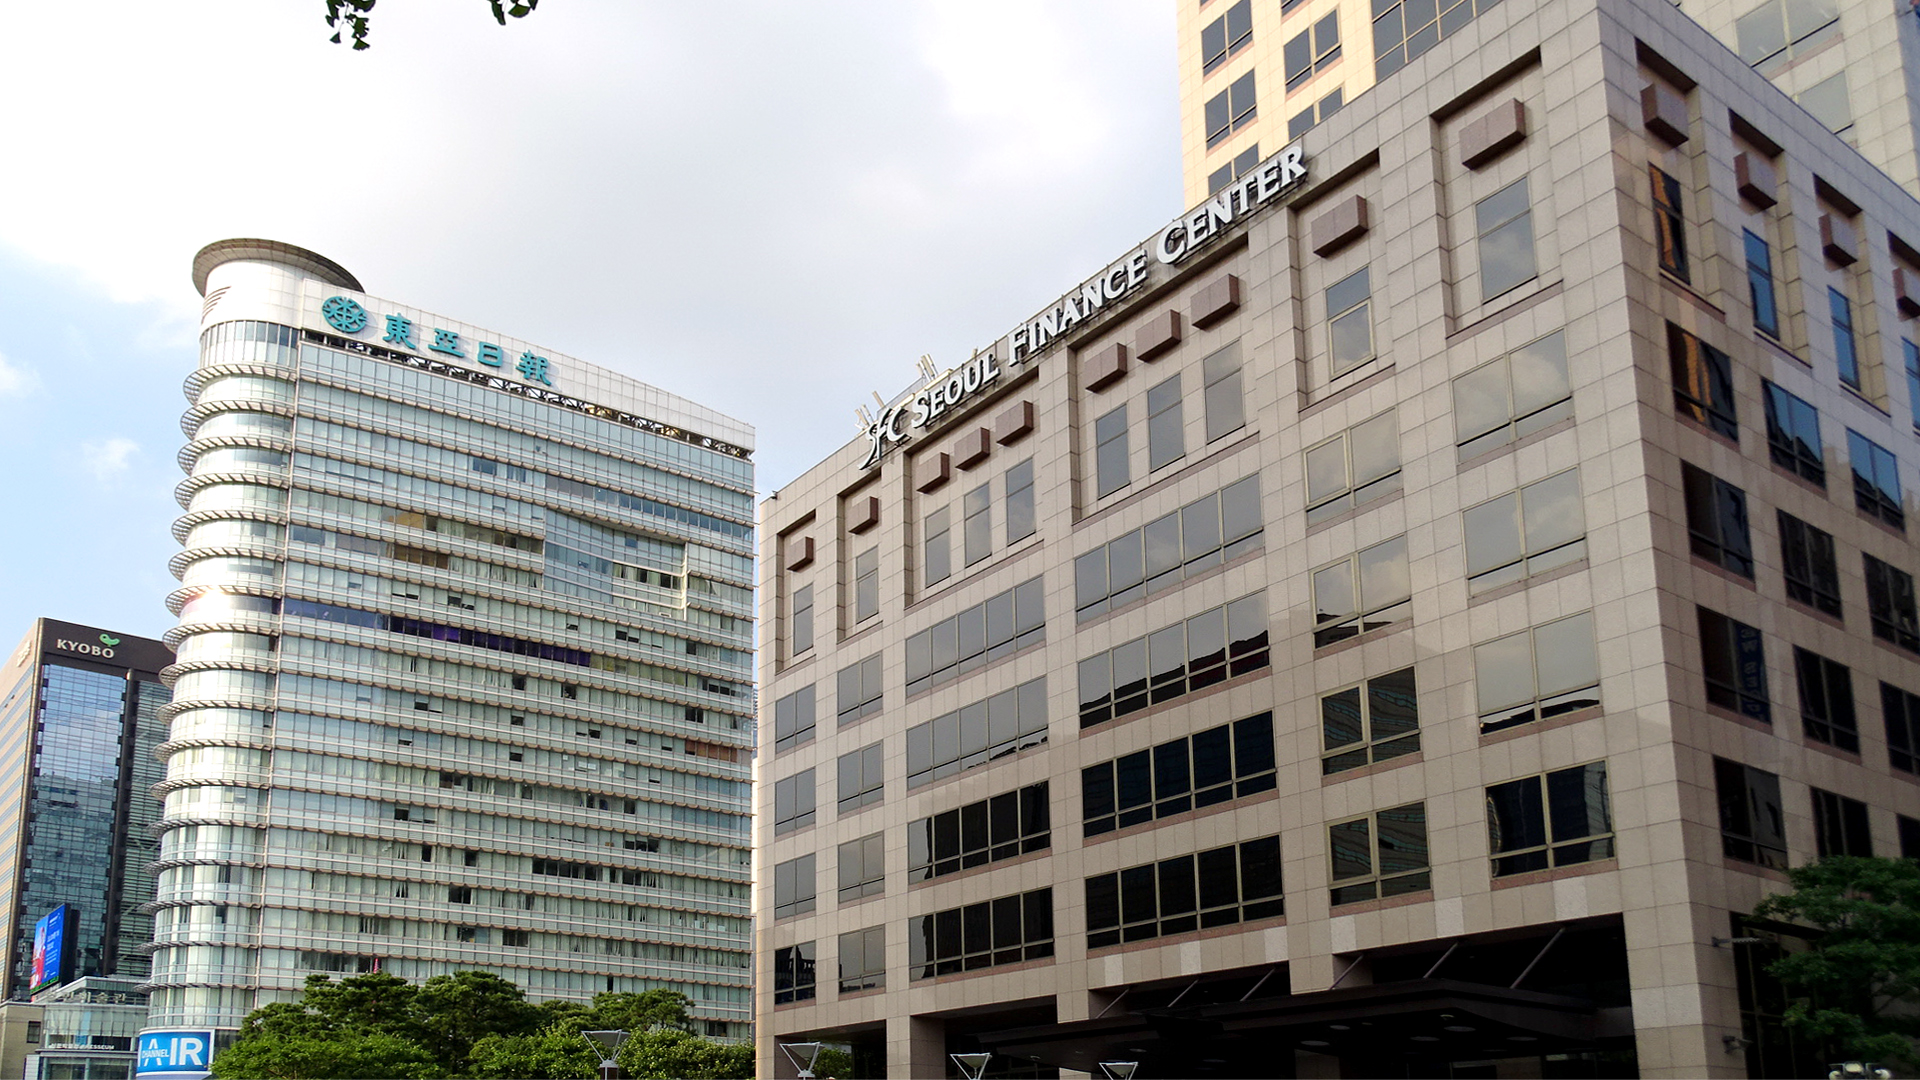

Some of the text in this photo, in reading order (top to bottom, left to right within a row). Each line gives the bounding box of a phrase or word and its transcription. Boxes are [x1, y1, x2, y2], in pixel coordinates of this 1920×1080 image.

[911, 353, 1000, 428] SEOUL
[1008, 249, 1148, 367] FINANCE
[1156, 145, 1306, 265] CENTER
[57, 638, 115, 659] KYOBO
